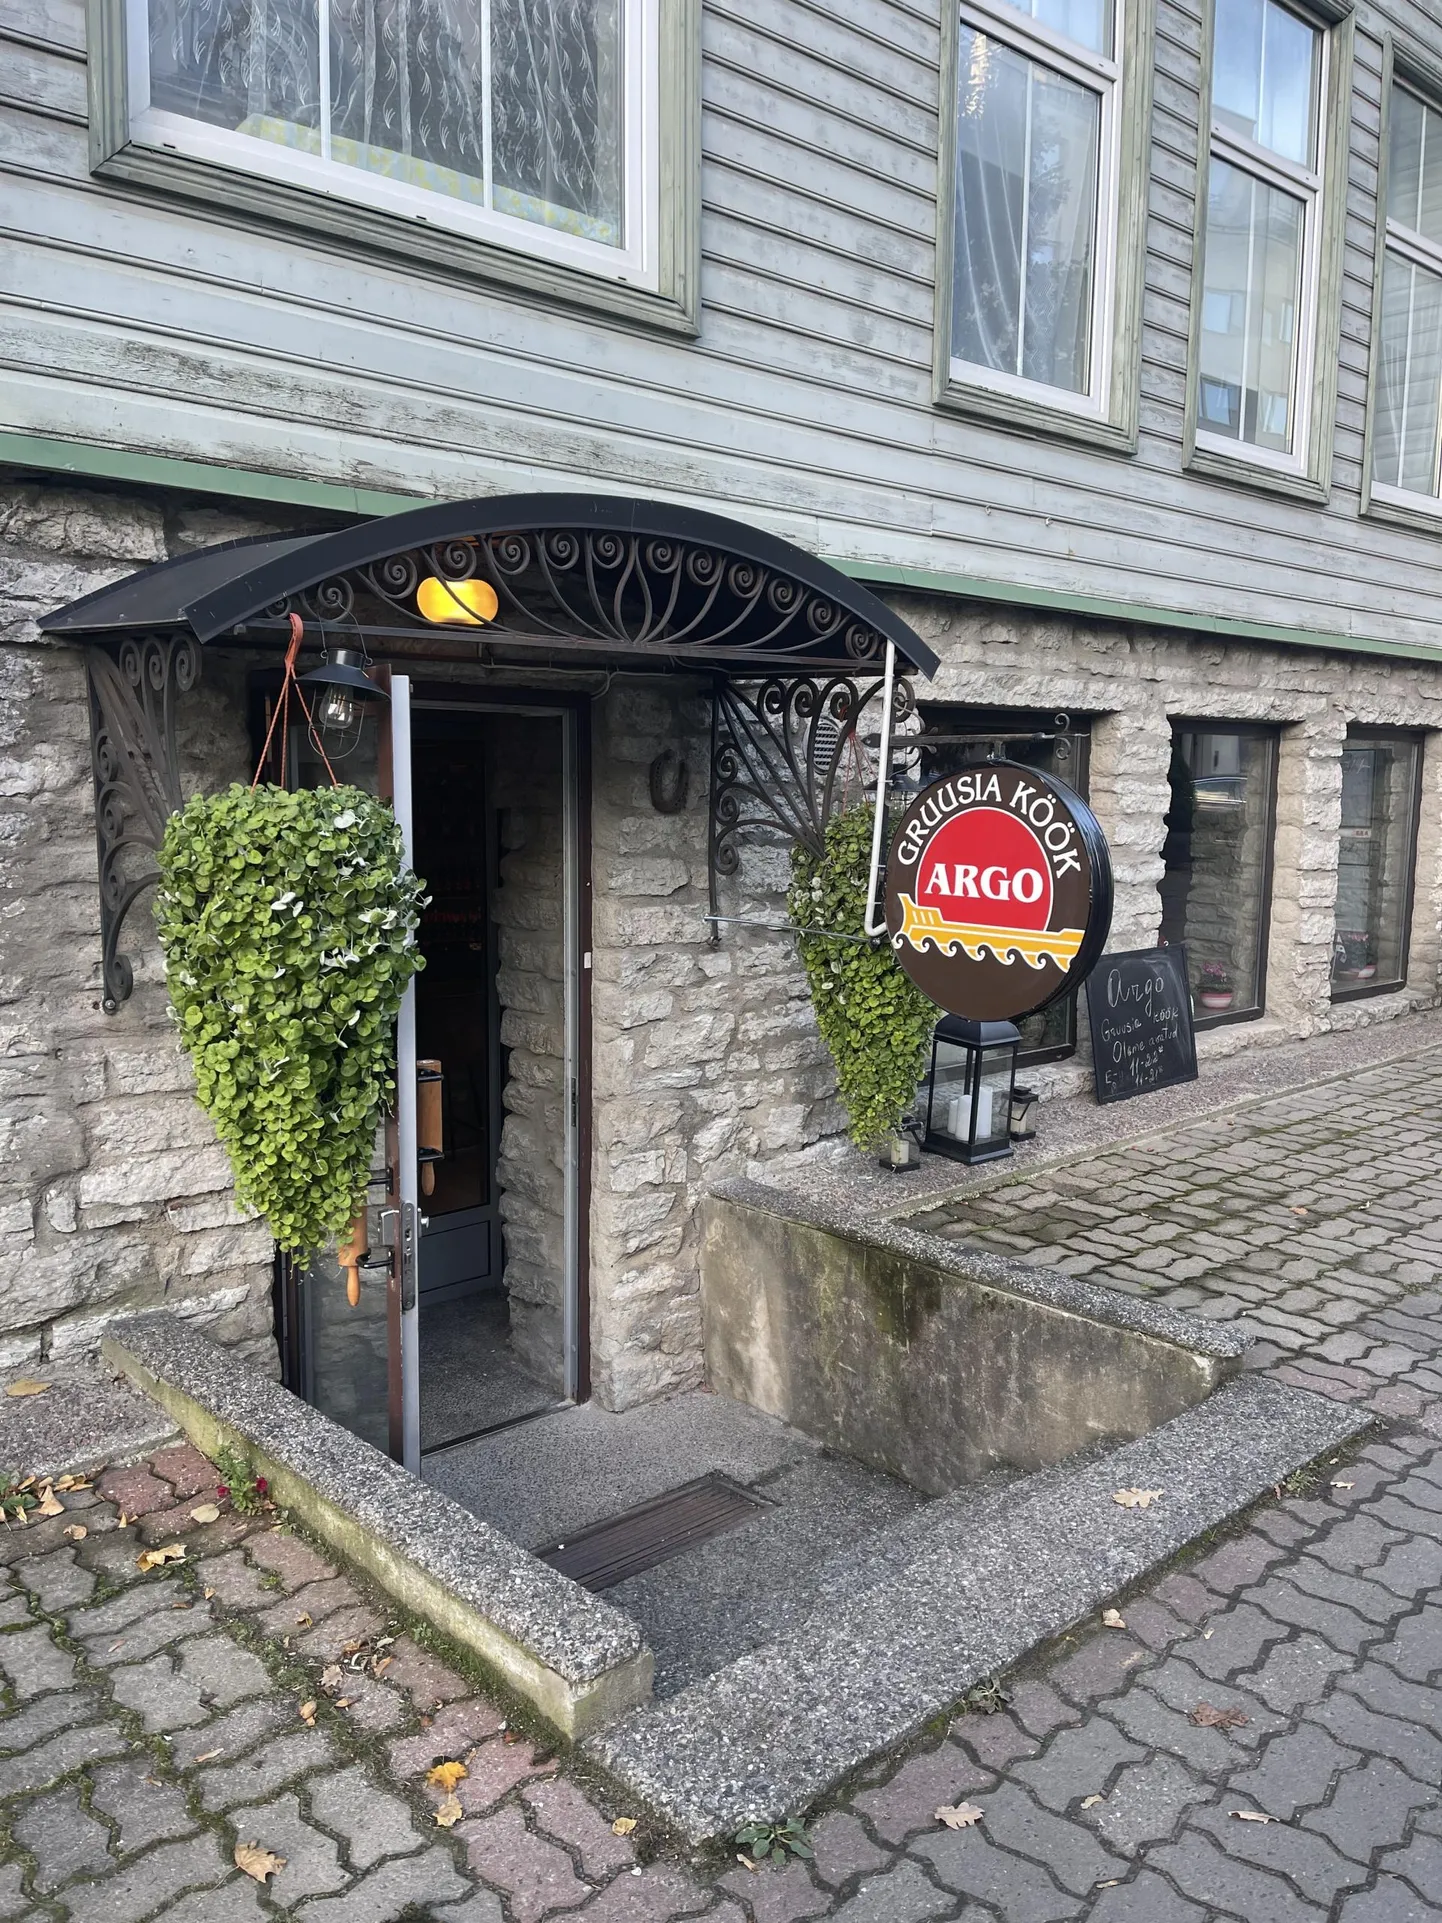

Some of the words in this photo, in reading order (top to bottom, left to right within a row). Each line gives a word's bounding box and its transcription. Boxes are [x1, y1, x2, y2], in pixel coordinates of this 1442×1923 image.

[897, 773, 1002, 866] GRUUSIA
[1010, 780, 1082, 879] KÖÖK
[924, 862, 1044, 903] ARGO
[1107, 968, 1164, 1017] Argo
[1101, 1018, 1142, 1042] Gruusia
